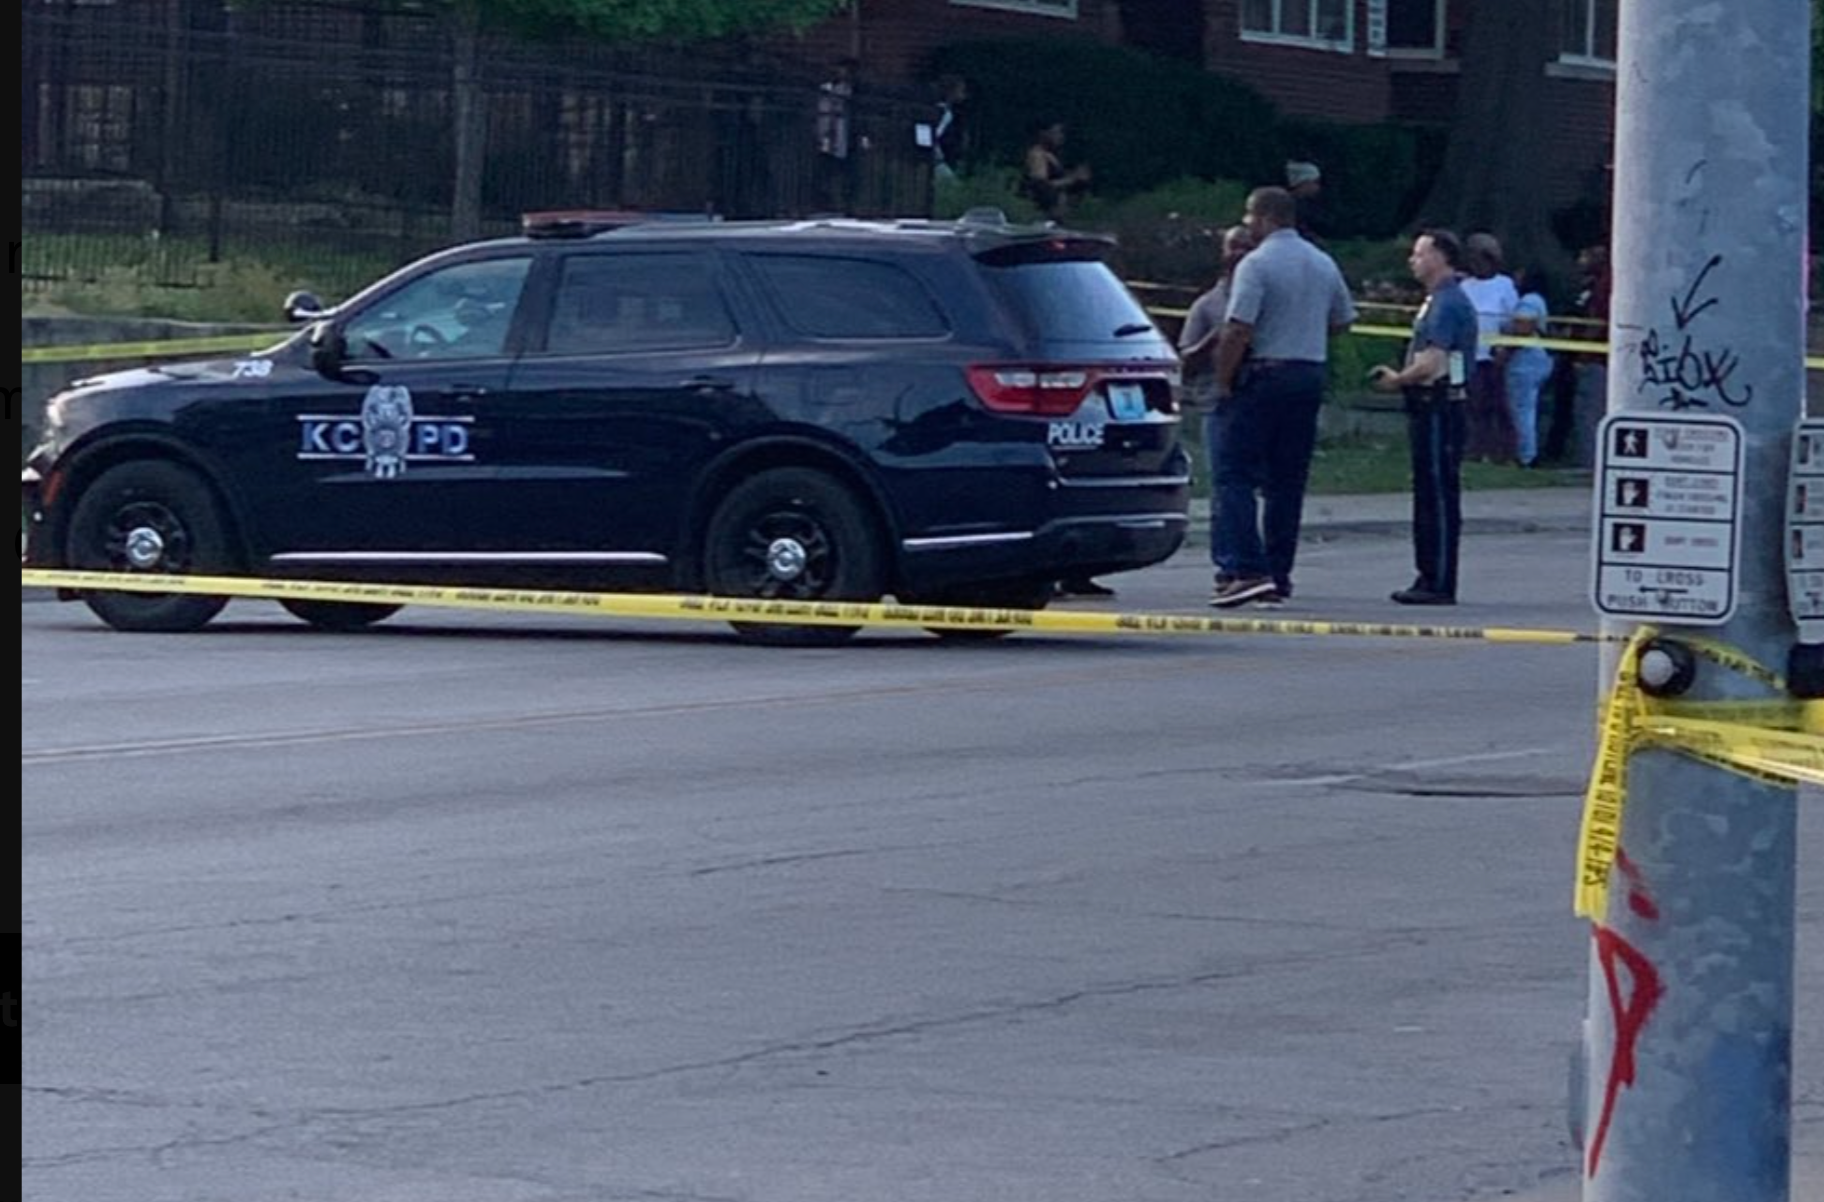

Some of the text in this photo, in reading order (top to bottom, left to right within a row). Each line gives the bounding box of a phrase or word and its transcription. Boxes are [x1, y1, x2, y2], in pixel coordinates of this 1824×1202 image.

[302, 422, 468, 453] KC PD
[1048, 422, 1105, 444] POLICE
[1624, 569, 1704, 587] TO CROSS
[1607, 594, 1718, 613] PUSH UTTON
